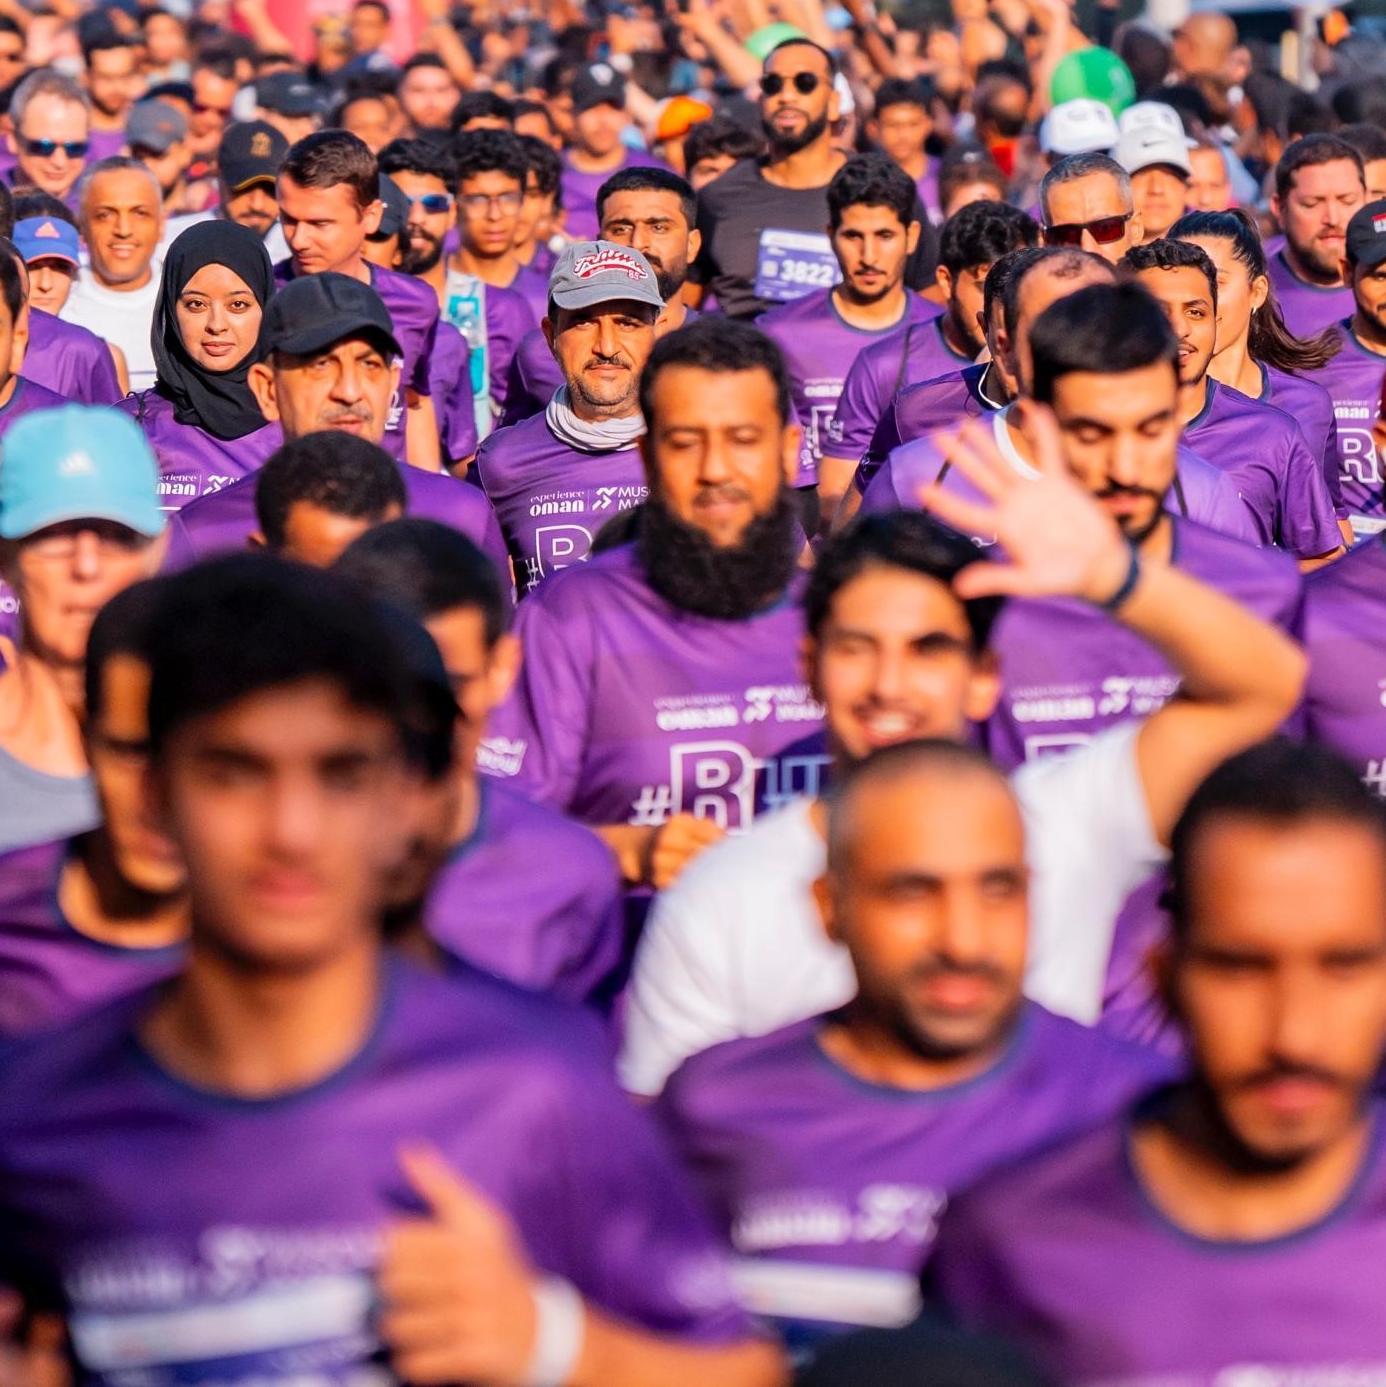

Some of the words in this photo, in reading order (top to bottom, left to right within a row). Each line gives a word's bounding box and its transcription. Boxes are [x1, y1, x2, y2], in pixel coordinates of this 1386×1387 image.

[156, 482, 196, 495] man
[618, 486, 649, 498] MUS
[530, 490, 585, 503] experience
[529, 499, 585, 517] oman
